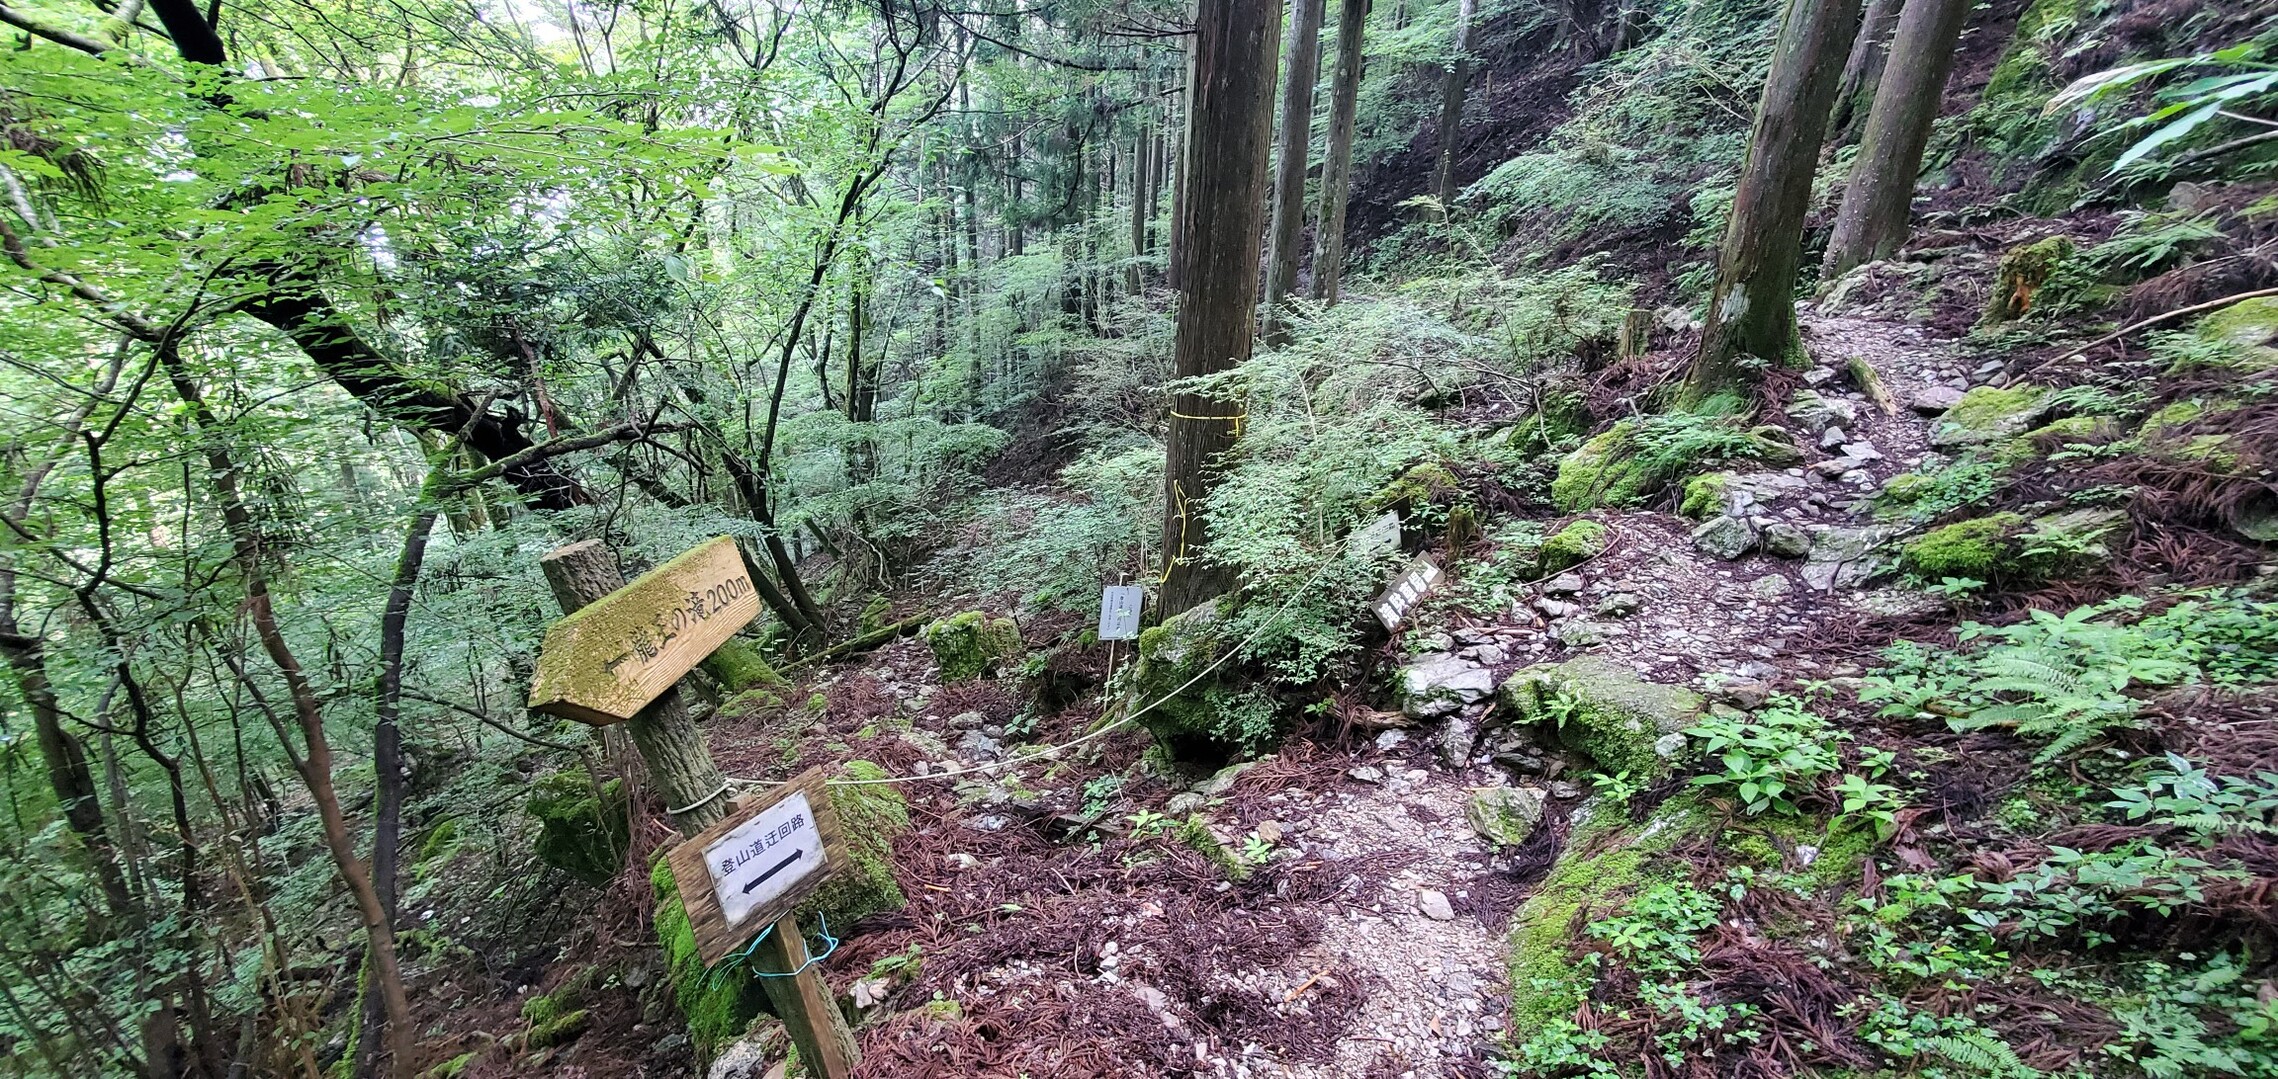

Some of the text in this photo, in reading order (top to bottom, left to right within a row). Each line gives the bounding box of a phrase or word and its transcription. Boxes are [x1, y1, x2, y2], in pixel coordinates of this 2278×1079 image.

[721, 813, 805, 877] 登山道迂回路
